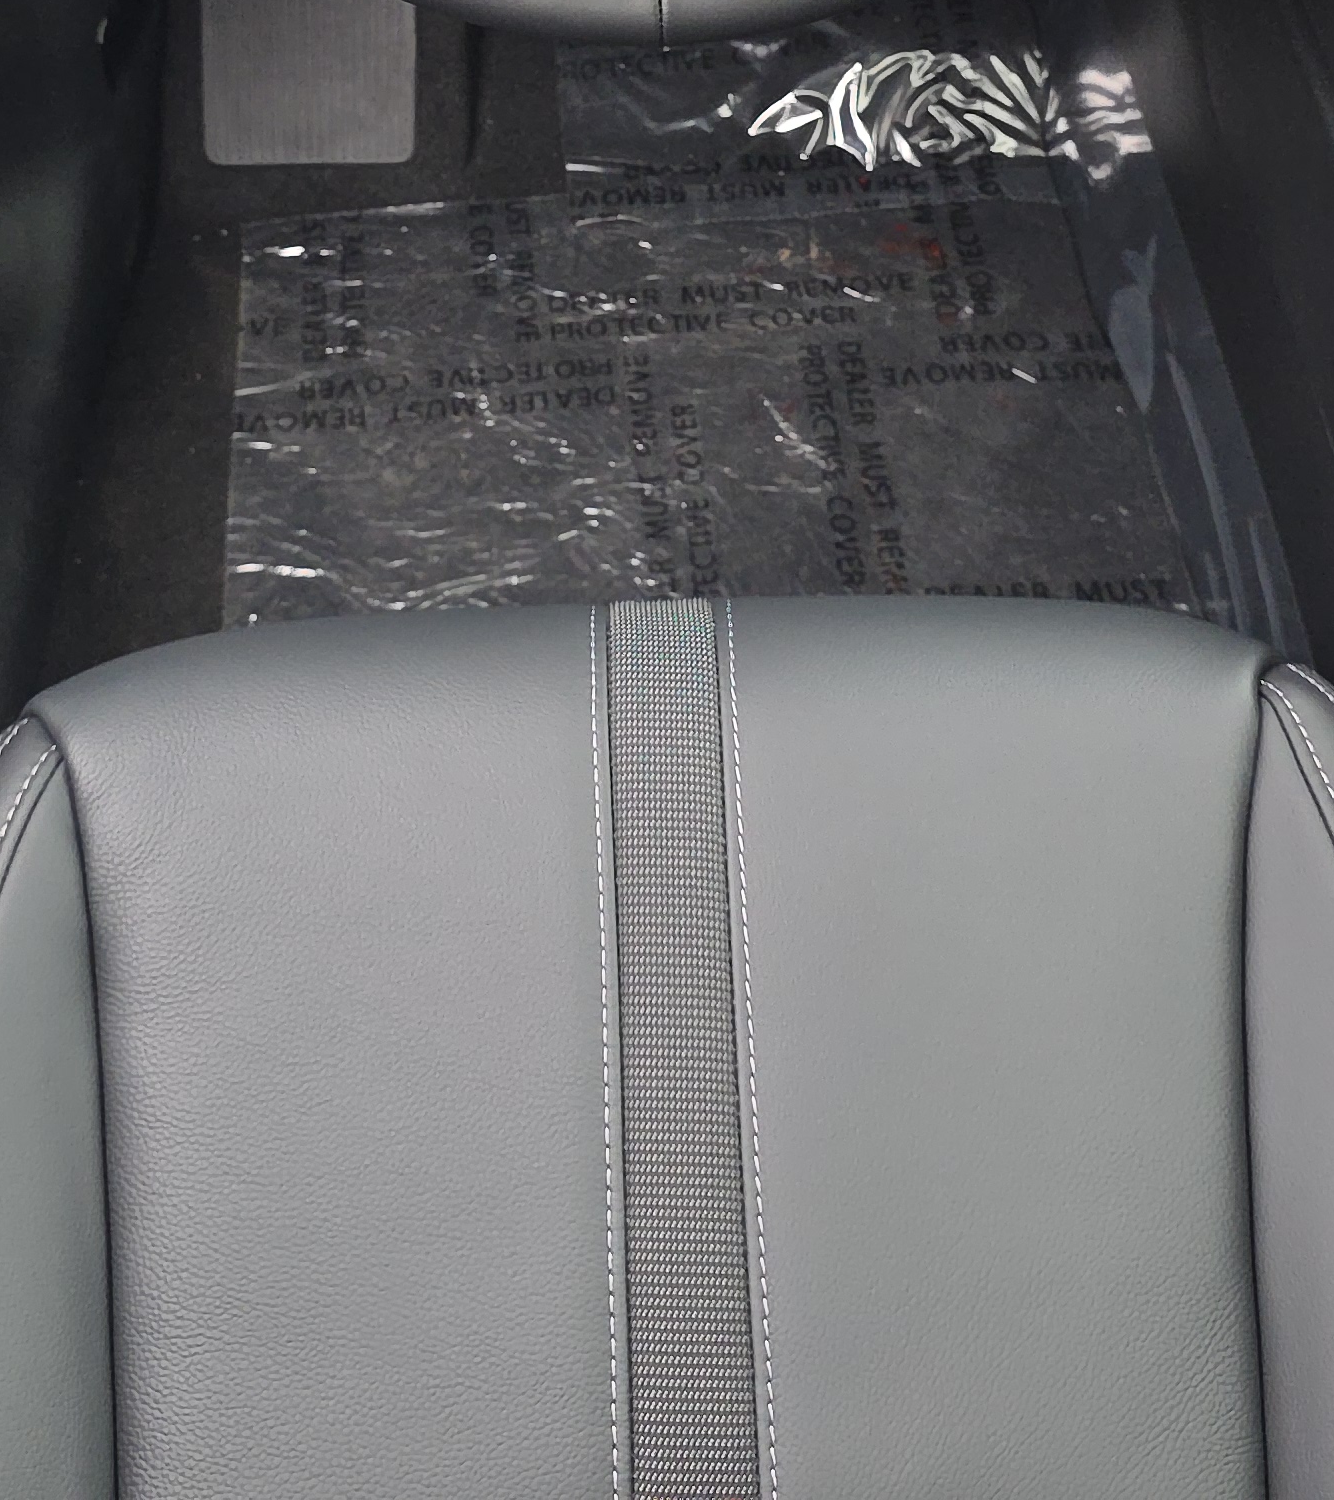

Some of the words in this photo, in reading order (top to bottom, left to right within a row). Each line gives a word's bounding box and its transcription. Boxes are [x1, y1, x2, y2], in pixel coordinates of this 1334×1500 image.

[681, 284, 763, 306] MUST
[787, 271, 914, 297] REMOVE
[550, 310, 728, 341] PROTECTIVE
[749, 305, 857, 332] COVER
[938, 331, 1050, 354] COVER
[387, 397, 476, 424] MUST
[499, 386, 616, 414] DEALER
[837, 341, 877, 427] DEALER
[858, 441, 897, 511] MUST
[670, 403, 704, 485] COVER
[827, 496, 867, 588] COVER
